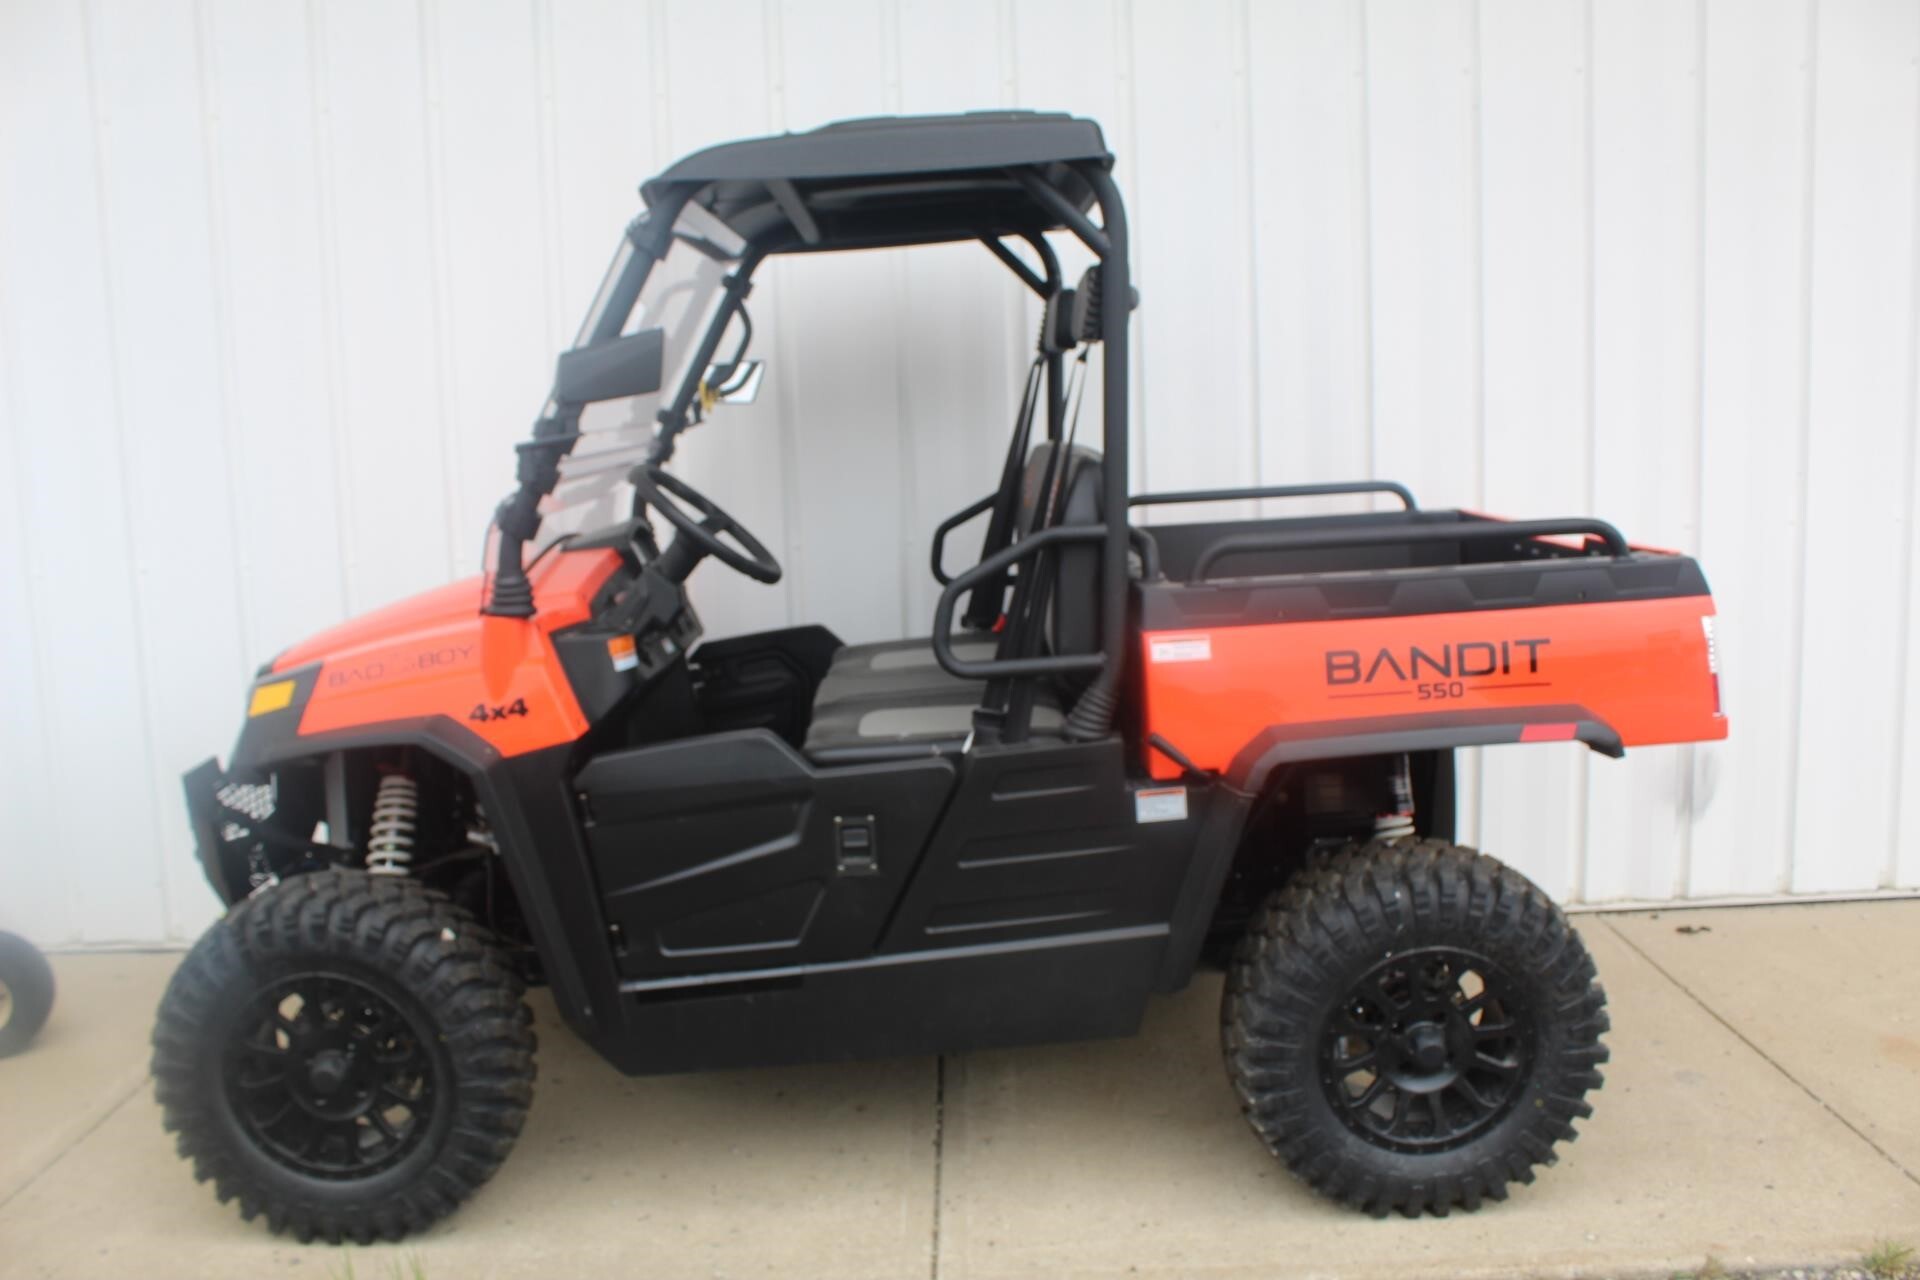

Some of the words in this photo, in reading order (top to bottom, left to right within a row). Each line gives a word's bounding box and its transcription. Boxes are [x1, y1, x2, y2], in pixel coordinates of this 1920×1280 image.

[328, 662, 384, 688] BAD
[418, 643, 475, 669] BOY
[1325, 639, 1551, 685] BANDIT
[1417, 682, 1464, 700] 550
[469, 698, 528, 721] 4x4
